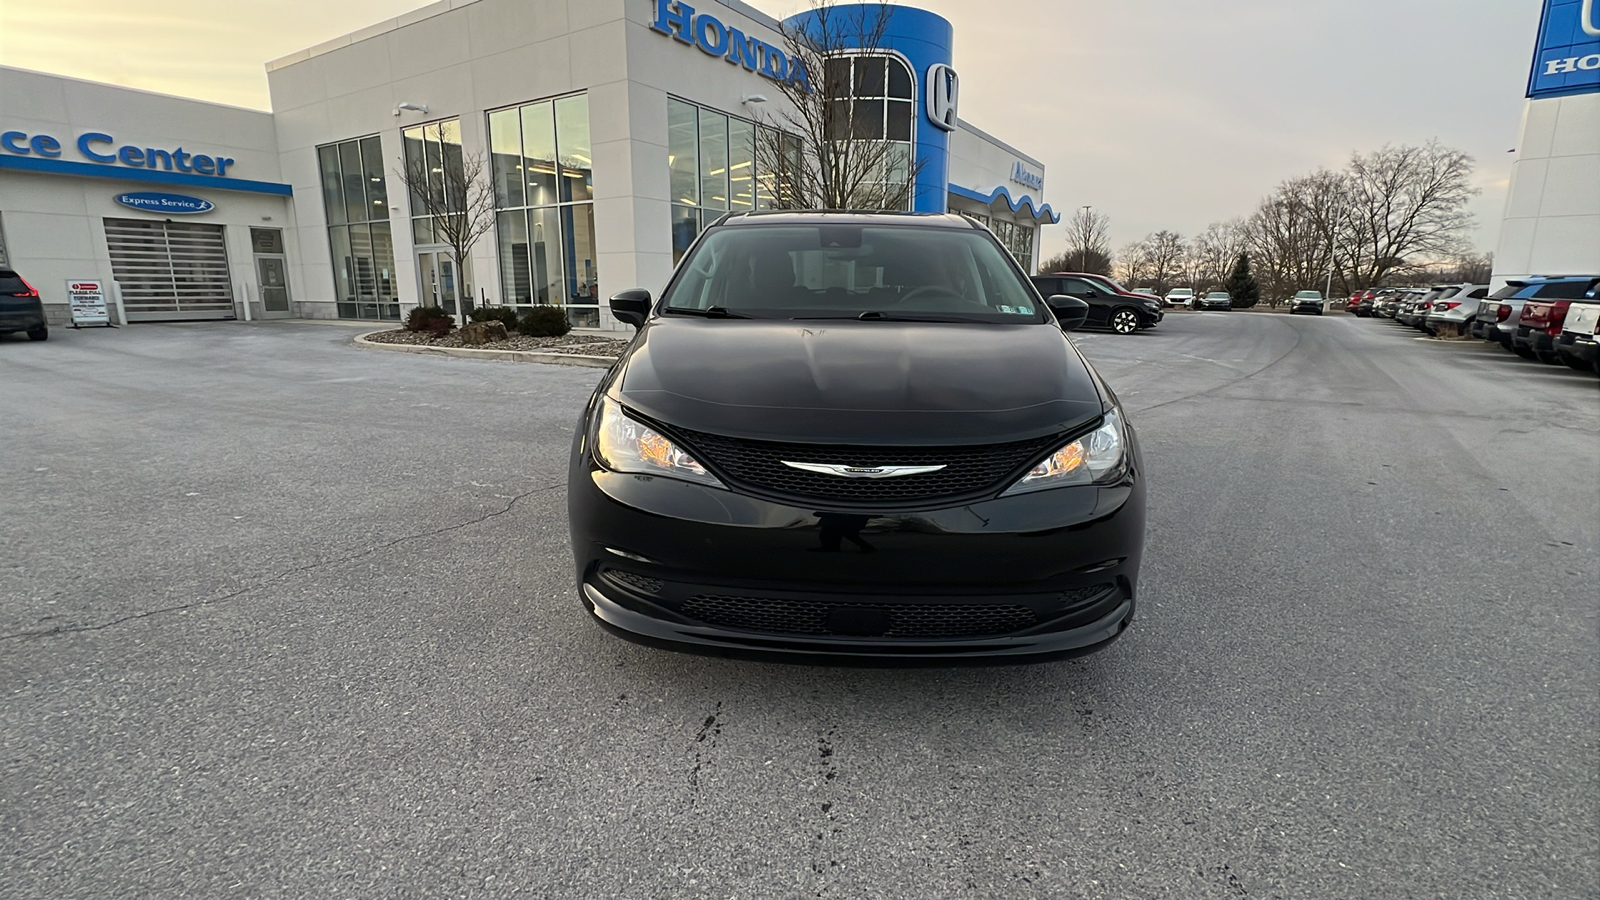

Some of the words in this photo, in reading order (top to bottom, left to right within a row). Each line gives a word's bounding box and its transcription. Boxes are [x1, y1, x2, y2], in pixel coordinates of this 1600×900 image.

[651, 0, 813, 94] HONDA
[1543, 53, 1600, 75] HO
[0, 131, 61, 157] ce
[77, 132, 235, 176] Center
[122, 196, 159, 206] Express
[161, 198, 195, 208] Service
